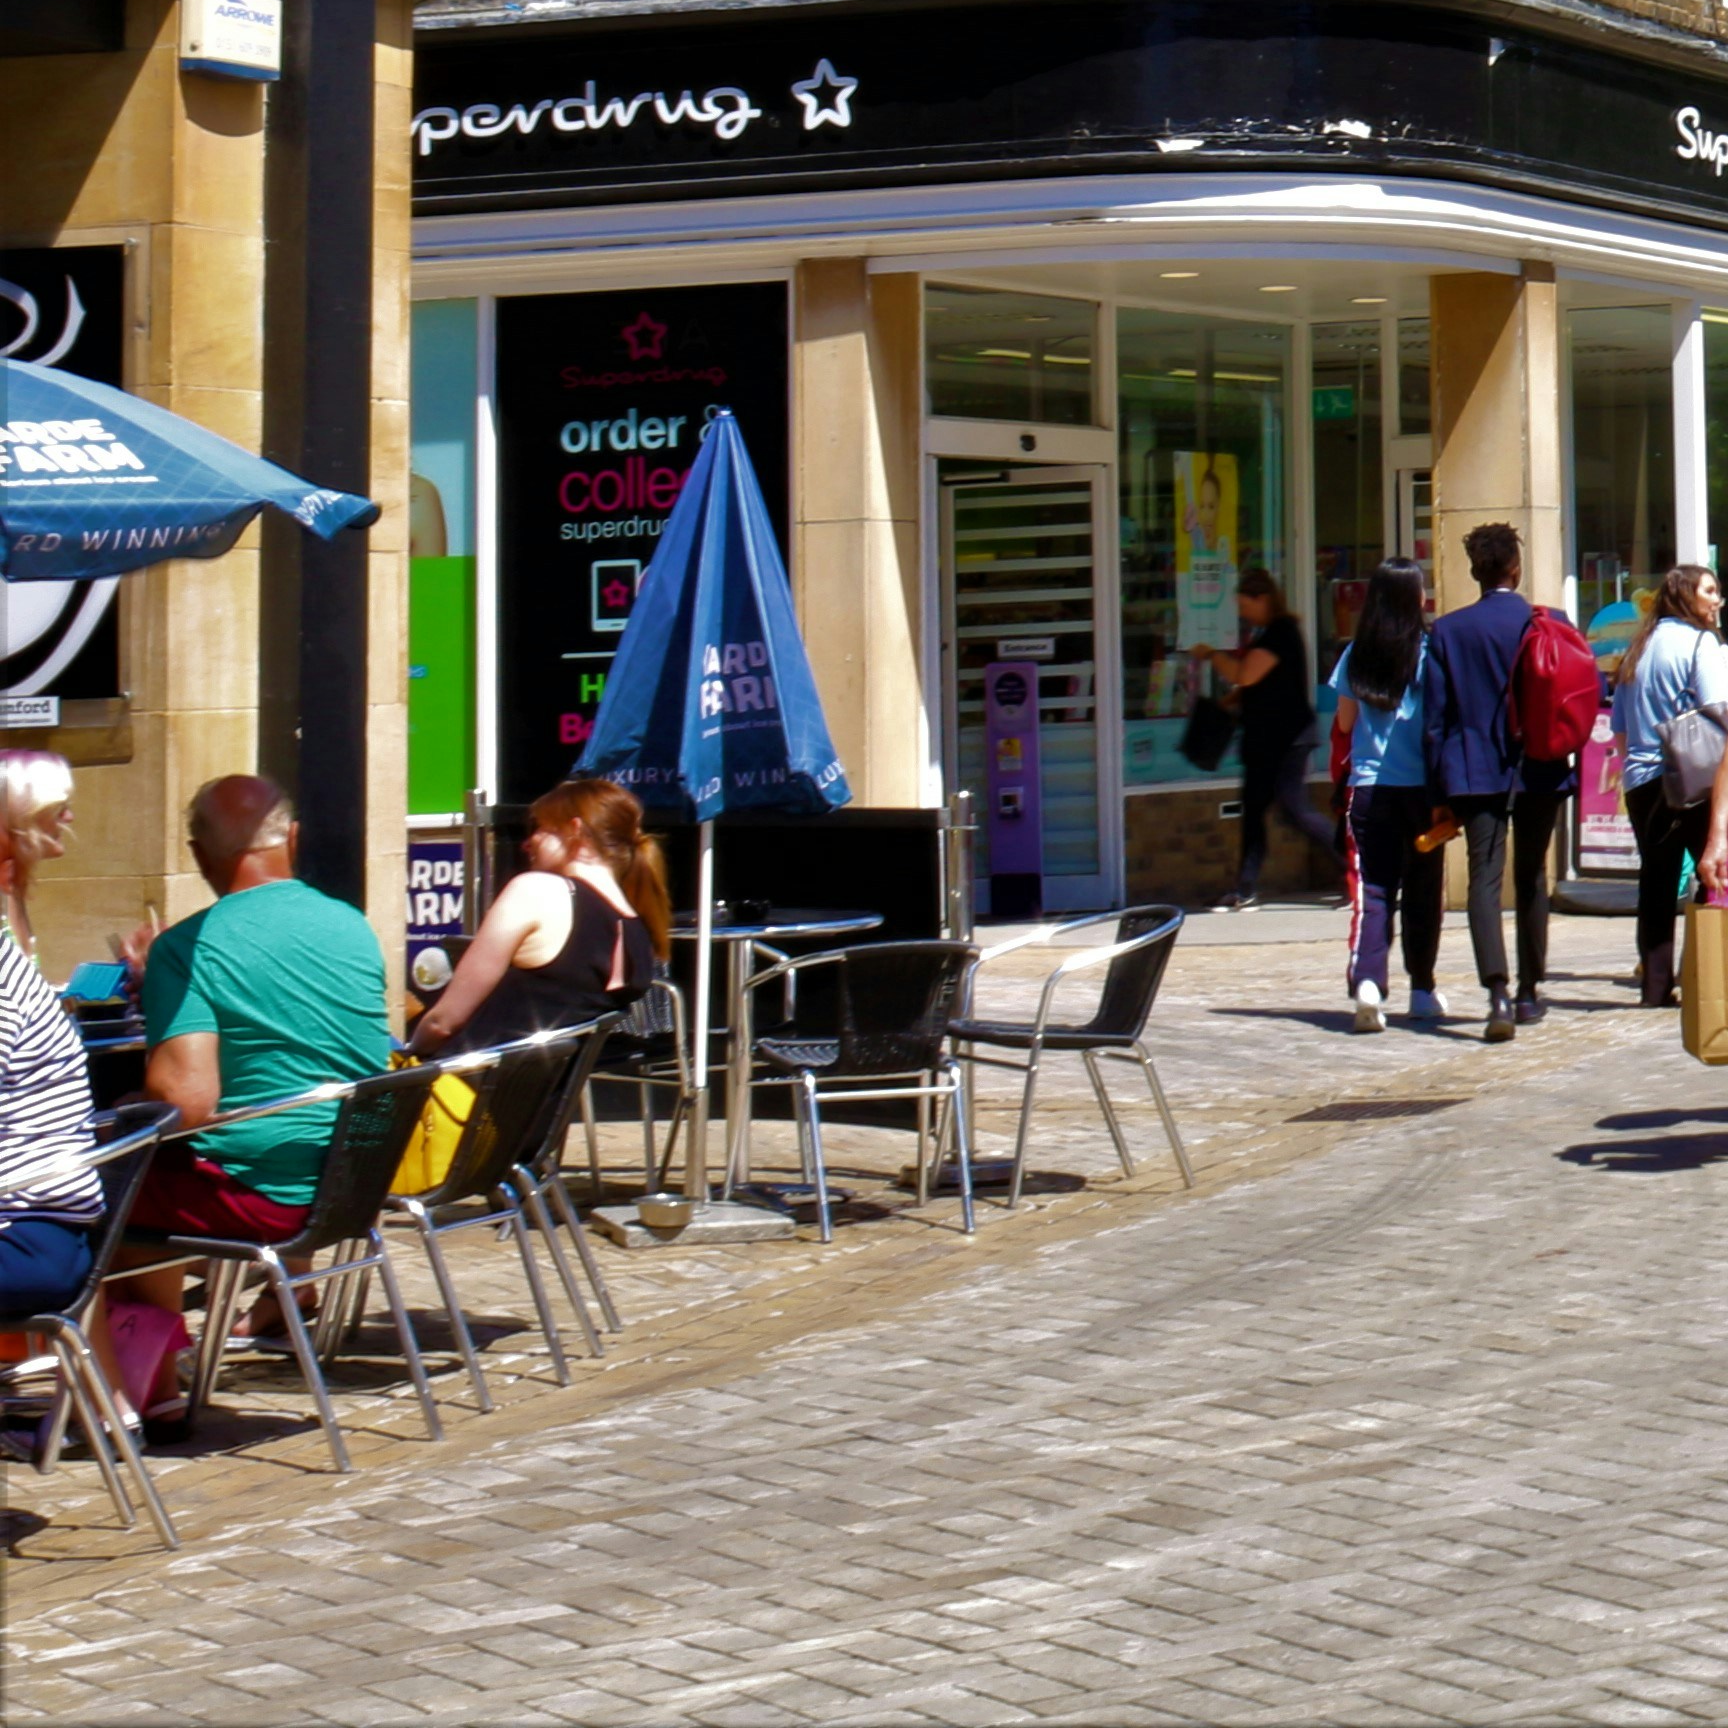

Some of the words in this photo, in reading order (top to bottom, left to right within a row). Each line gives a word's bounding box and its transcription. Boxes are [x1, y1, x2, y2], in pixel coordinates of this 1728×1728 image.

[560, 408, 687, 454] order
[558, 456, 692, 514] colle
[405, 860, 464, 890] RDE
